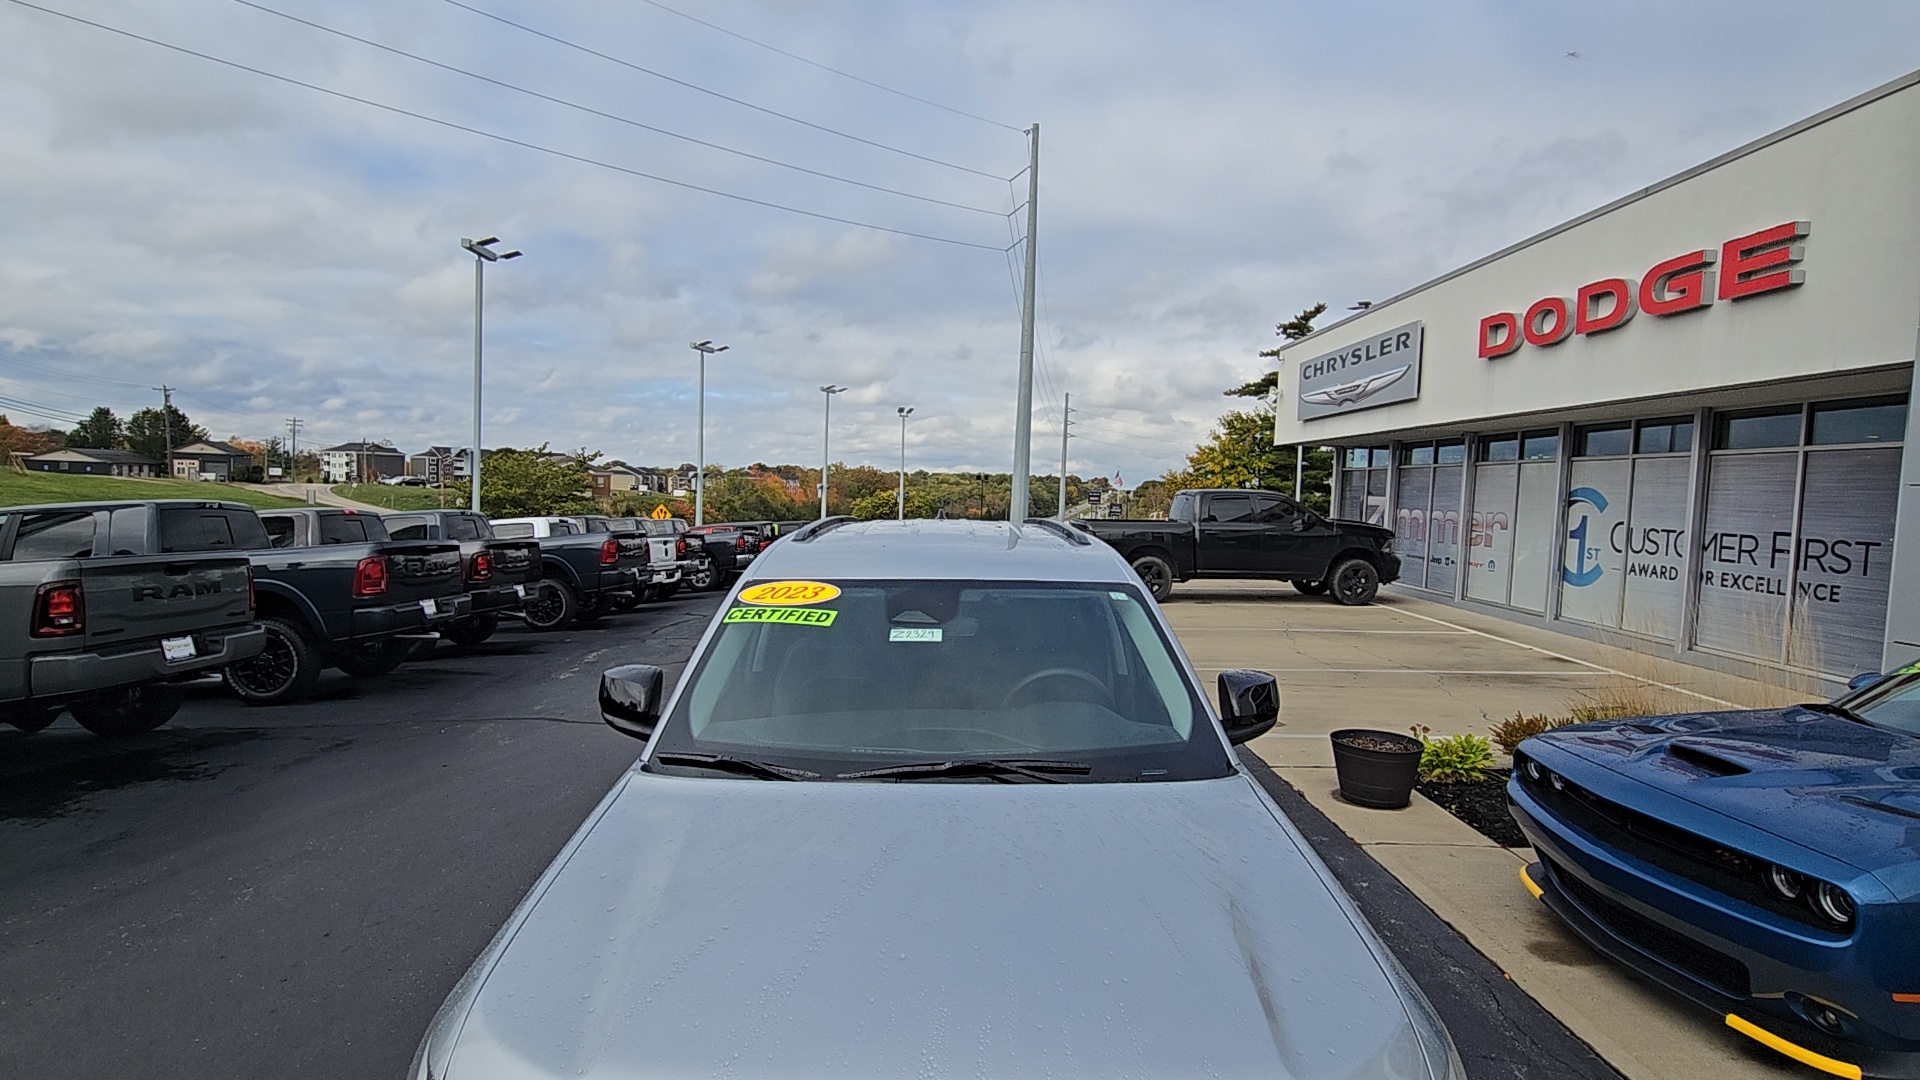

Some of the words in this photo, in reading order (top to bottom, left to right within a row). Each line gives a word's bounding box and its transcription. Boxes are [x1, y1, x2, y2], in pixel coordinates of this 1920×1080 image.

[1478, 220, 1811, 358] DODGE
[1303, 332, 1410, 380] CHRYSLER
[1364, 496, 1508, 548] Zmmer
[1770, 531, 1881, 577] FIRST
[132, 581, 221, 602] RAM
[752, 586, 826, 601] 2023
[1628, 562, 1678, 581] AWARD
[1720, 573, 1841, 603] EXCELLNCE
[727, 608, 831, 623] CERTIFIED
